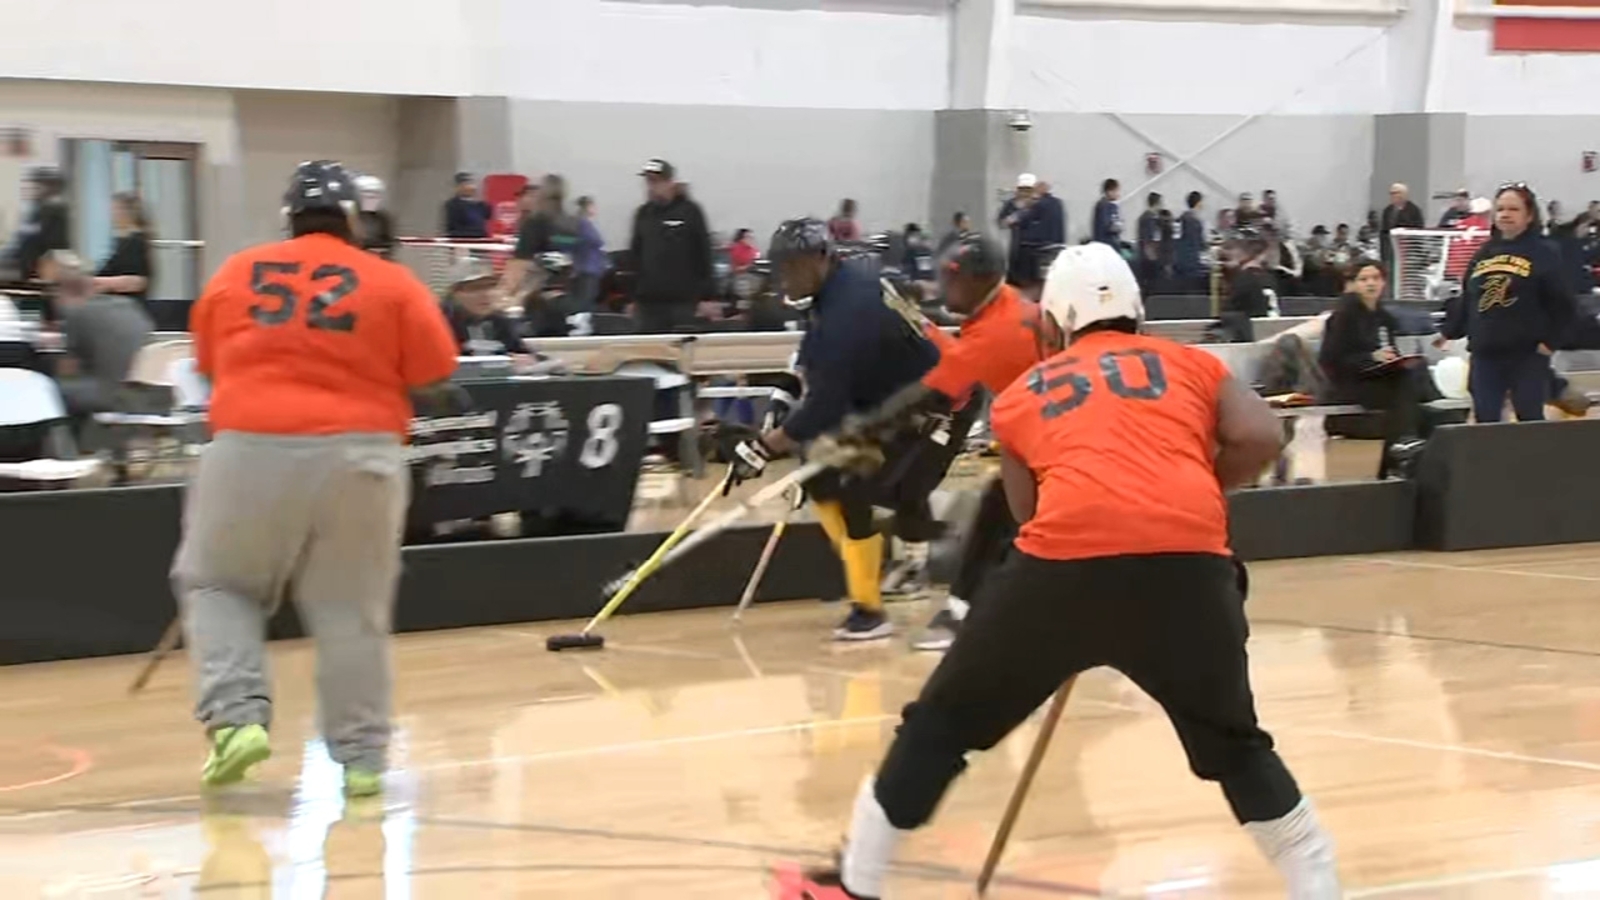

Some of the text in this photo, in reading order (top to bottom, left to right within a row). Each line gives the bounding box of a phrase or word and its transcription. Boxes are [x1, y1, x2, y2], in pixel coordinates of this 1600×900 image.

[248, 261, 359, 331] 52
[1026, 348, 1167, 420] 50
[579, 402, 623, 469] 8
